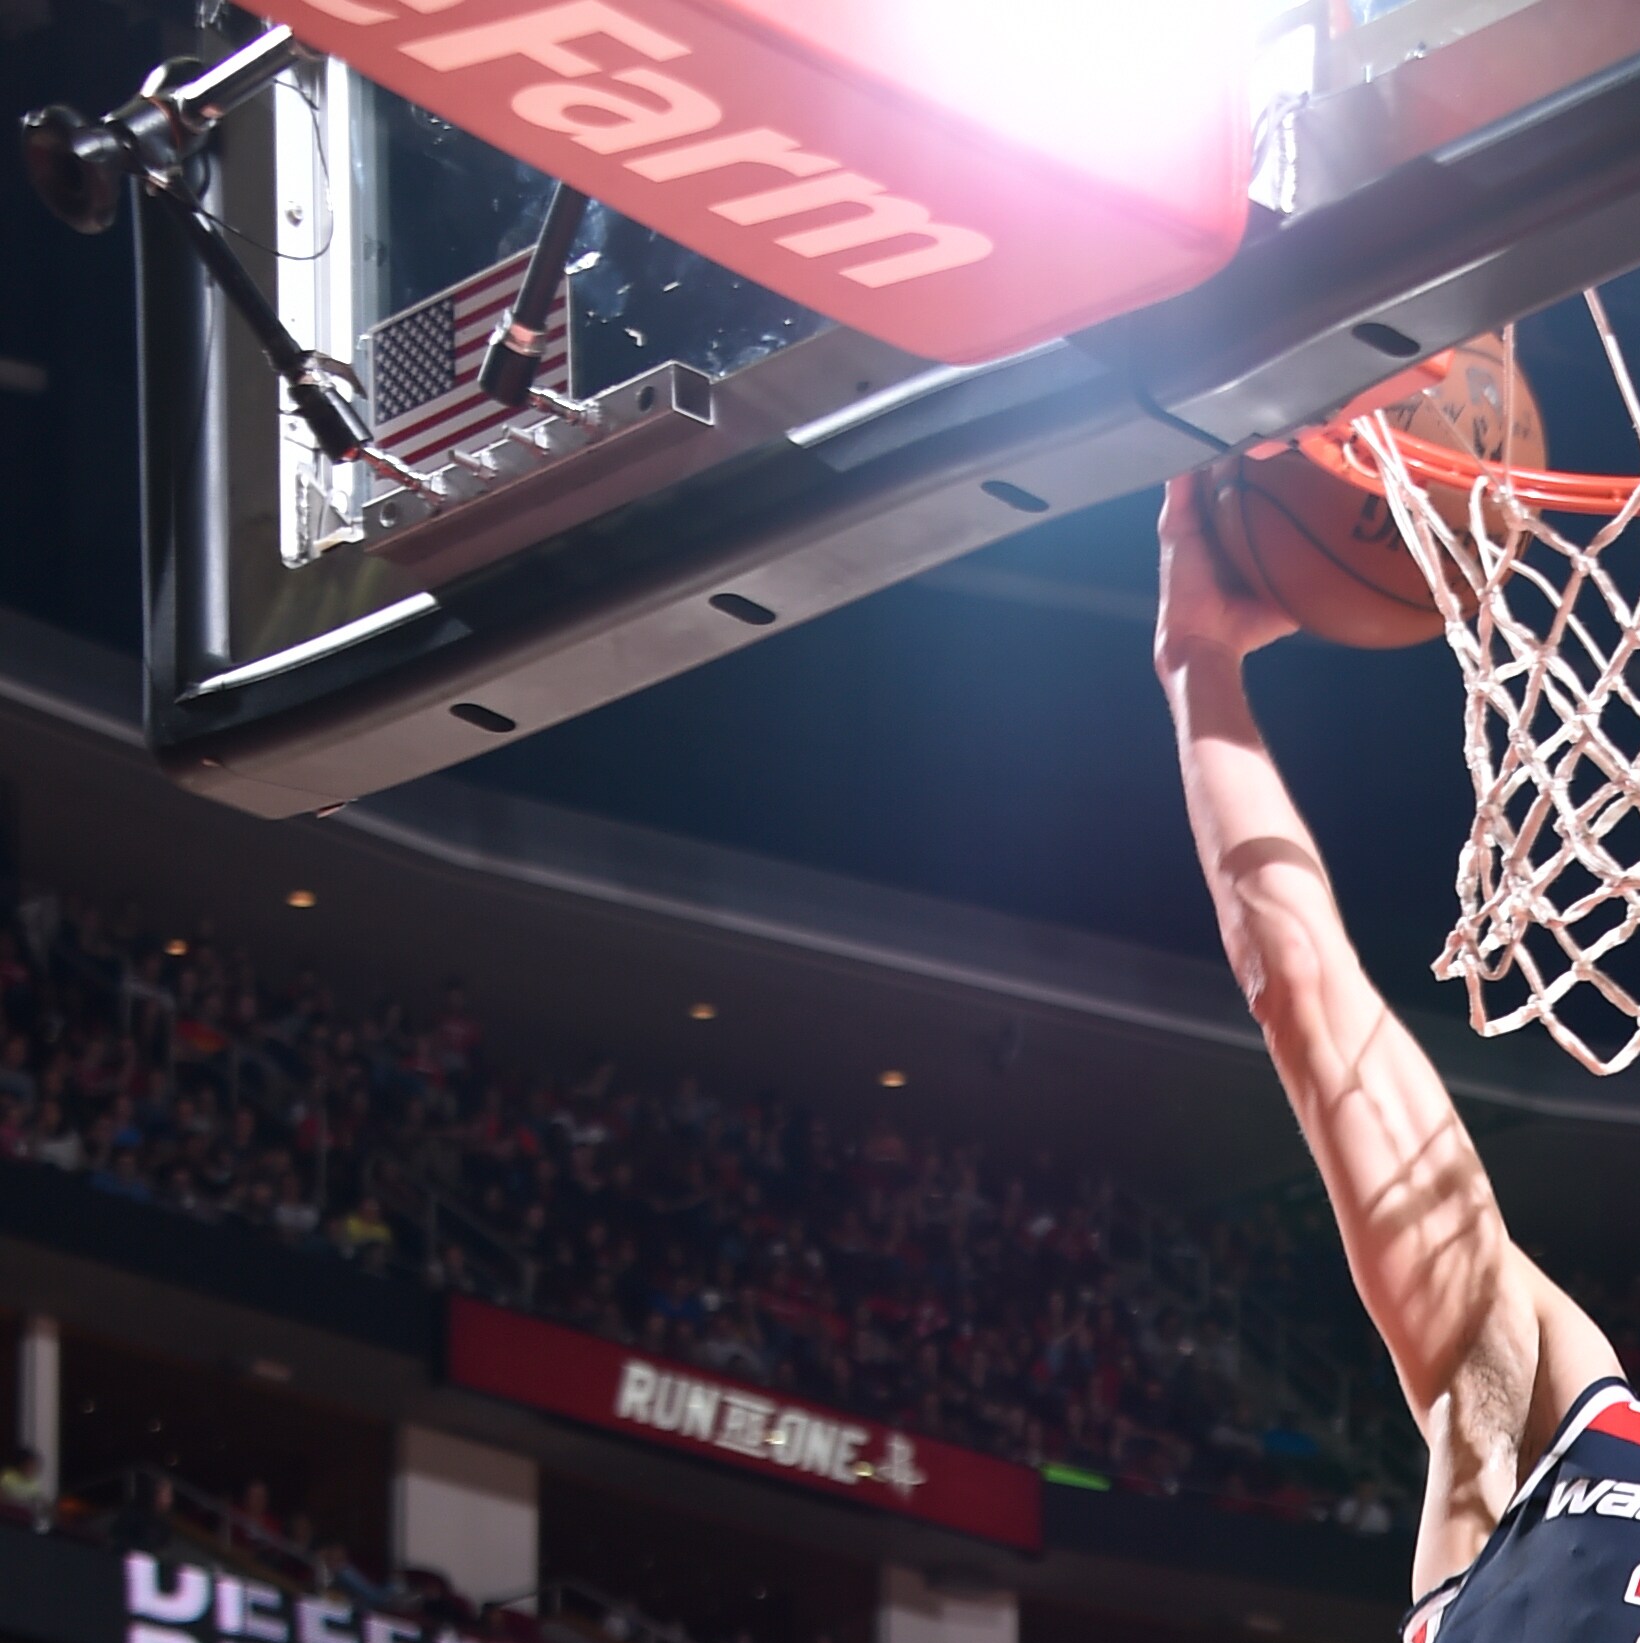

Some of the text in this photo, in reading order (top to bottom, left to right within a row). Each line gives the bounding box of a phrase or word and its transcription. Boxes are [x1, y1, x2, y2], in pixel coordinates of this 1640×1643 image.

[399, 0, 995, 290] Farm
[615, 1358, 721, 1442] RUN
[773, 1406, 869, 1487] ONE
